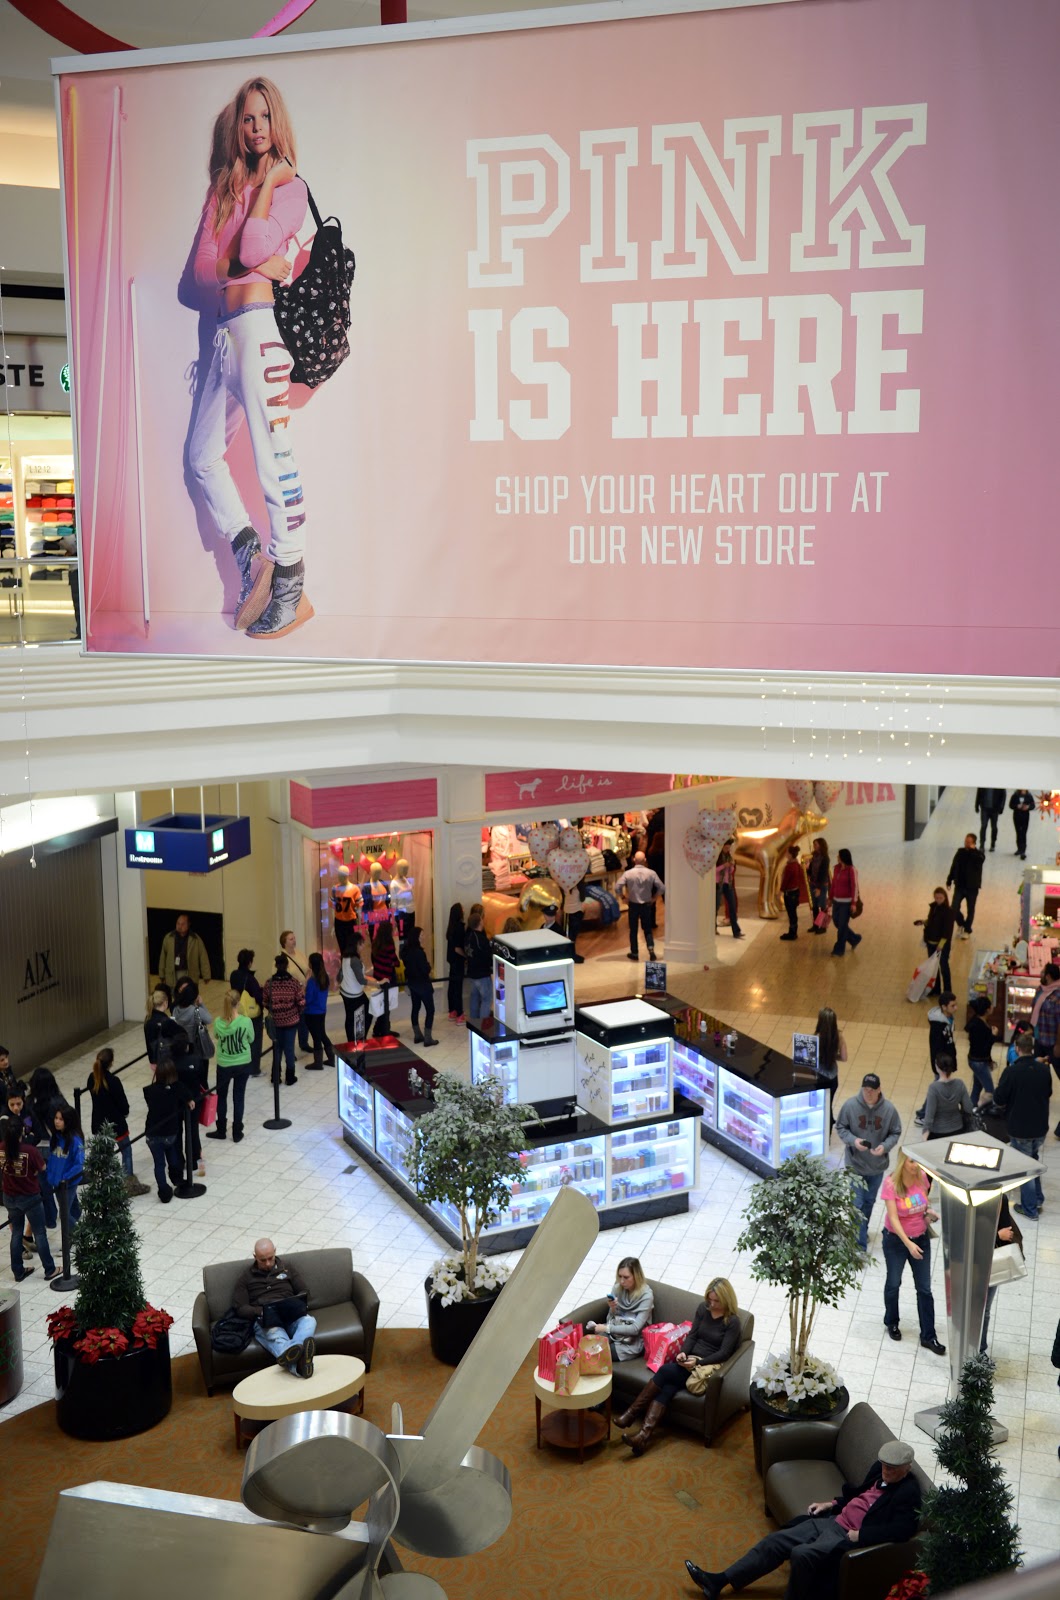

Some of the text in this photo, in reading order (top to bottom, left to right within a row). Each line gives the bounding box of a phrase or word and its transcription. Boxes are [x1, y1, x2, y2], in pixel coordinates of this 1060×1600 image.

[466, 102, 928, 289] PINK
[468, 288, 924, 442] IS HERE
[495, 471, 889, 515] SHOP YOUR HEART OUT AT
[569, 525, 816, 565] OUR NEW STORE
[555, 774, 594, 794] life
[841, 781, 896, 806] INK
[365, 844, 384, 854] PINK
[219, 1026, 247, 1055] PINK
[795, 1035, 813, 1044] SALE
